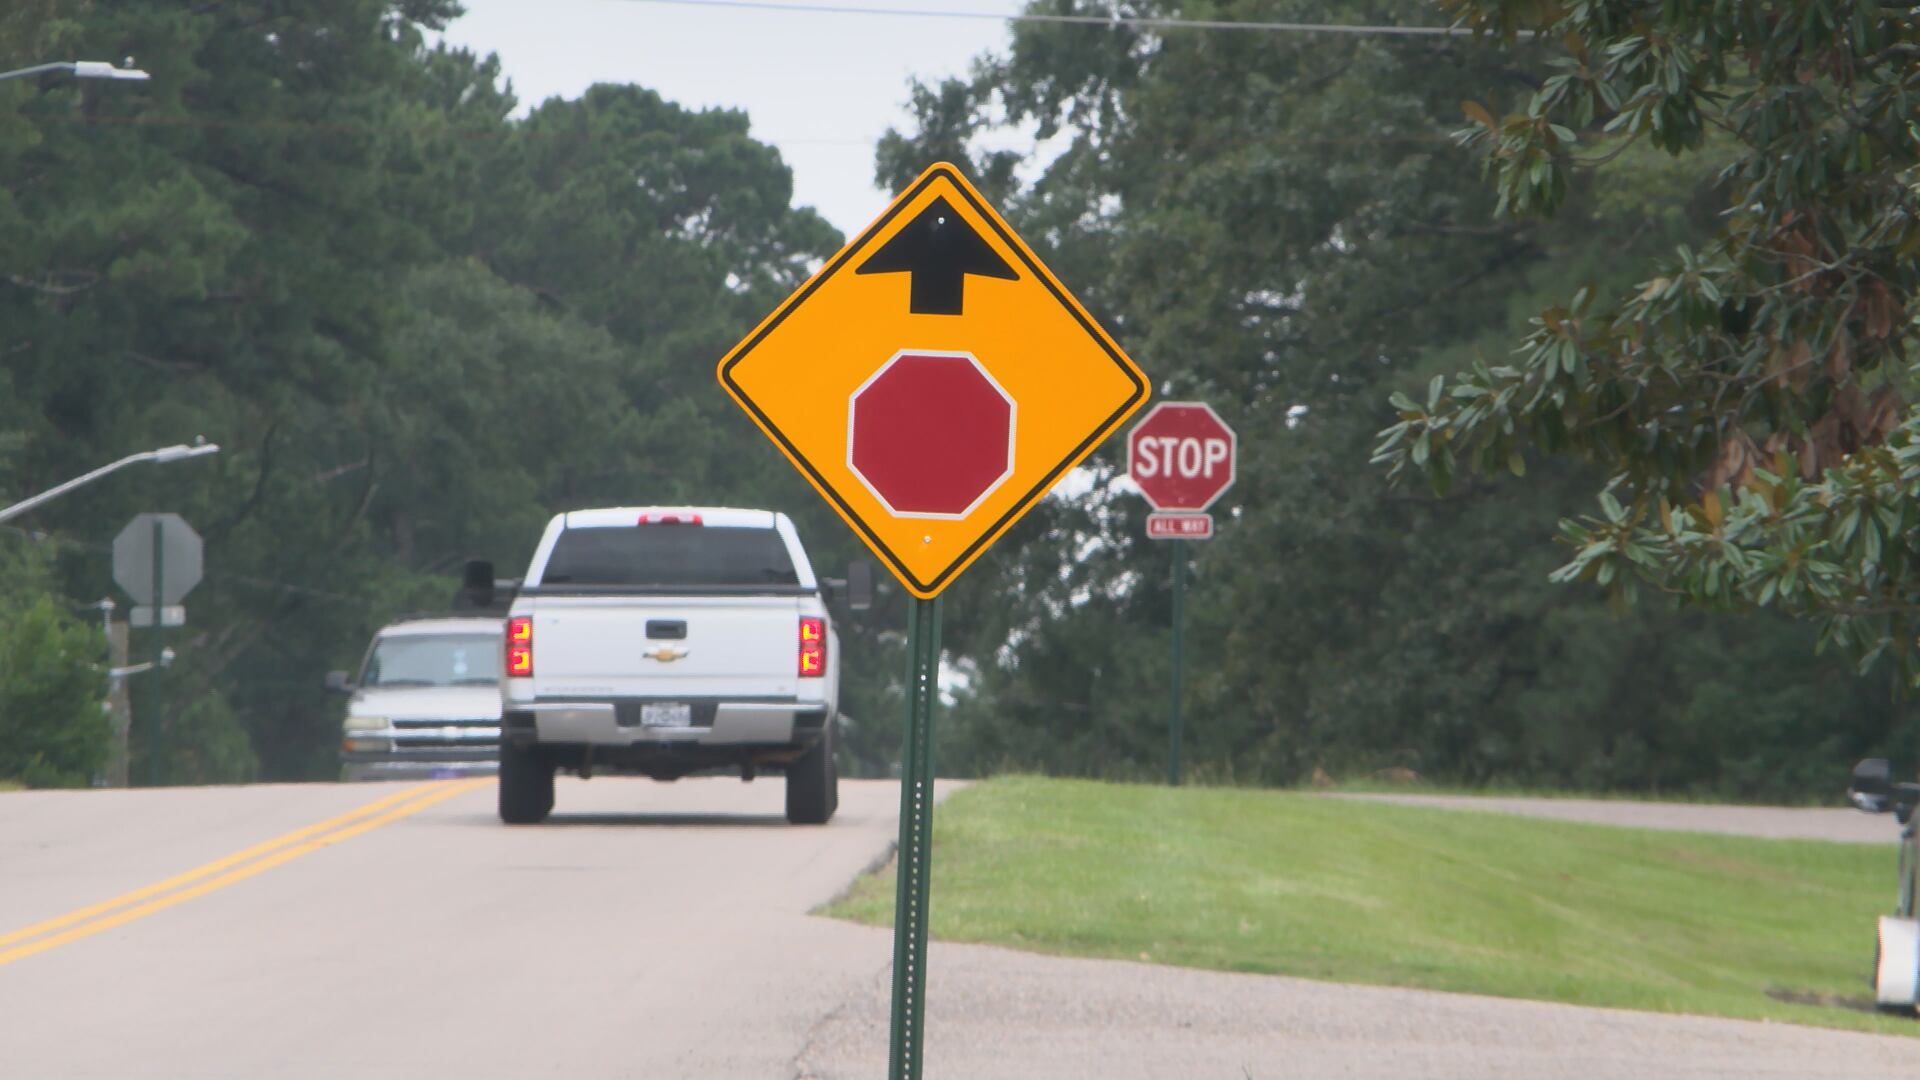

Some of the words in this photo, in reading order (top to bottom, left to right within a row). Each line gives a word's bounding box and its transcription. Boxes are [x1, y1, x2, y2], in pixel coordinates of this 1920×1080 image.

[1135, 436, 1228, 478] STOP
[1153, 519, 1175, 532] ALL
[1182, 519, 1206, 532] WAY
